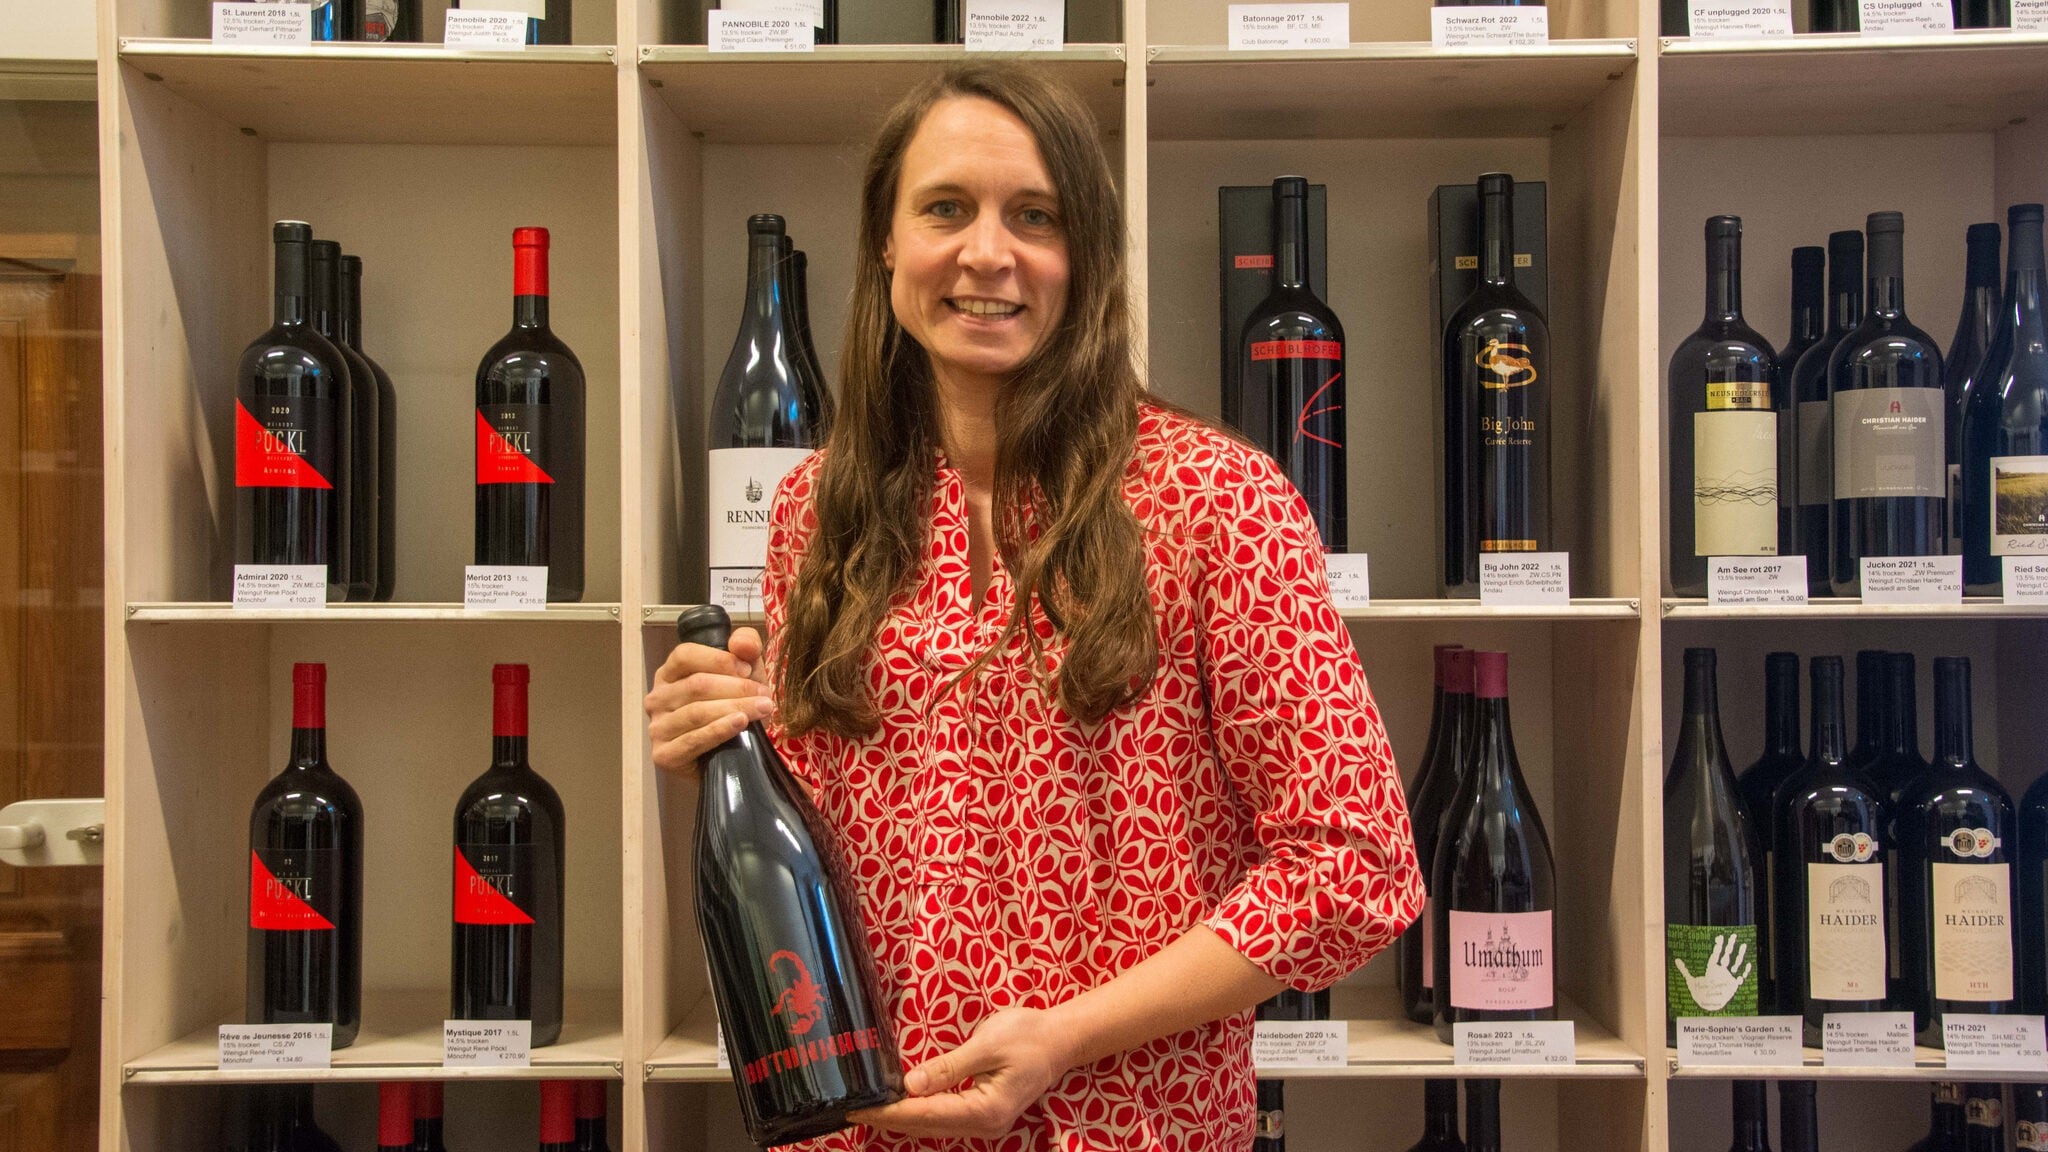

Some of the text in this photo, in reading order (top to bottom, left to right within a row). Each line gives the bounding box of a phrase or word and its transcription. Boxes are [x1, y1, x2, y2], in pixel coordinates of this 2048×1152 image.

[1877, 1, 1922, 10] Unplugged
[235, 9, 266, 17] Laurent
[267, 9, 286, 17] 2018
[1707, 8, 1750, 17] unplugged
[448, 16, 487, 24] Pannobile
[1011, 14, 1030, 22] 2022
[1242, 15, 1285, 23] Batonnage
[1499, 16, 1518, 24] 2022
[271, 406, 290, 414] 2020
[1481, 416, 1536, 435] Big John
[1508, 437, 1533, 446] Reserve
[1484, 563, 1498, 572] Big
[1499, 563, 1519, 571] John
[1520, 563, 1540, 571] 2022
[1866, 561, 1896, 569] Juckon
[2014, 565, 2033, 573] Ried
[1717, 566, 1731, 574] Am
[270, 573, 289, 581] 2020
[1820, 914, 1878, 926] HAIDER
[1945, 914, 2006, 926] HAIDER
[1464, 940, 1544, 974] Umathum
[1683, 1025, 1743, 1034] Marie-Sophie's
[1744, 1025, 1774, 1033] Garden
[1947, 1024, 1965, 1032] HTH
[1967, 1024, 1986, 1032] 2021
[220, 1032, 240, 1040] Rêve
[252, 1032, 291, 1040] Jeunesse
[293, 1031, 312, 1039] 2016
[446, 1029, 482, 1037] Mystique
[1305, 1031, 1324, 1039] 2020
